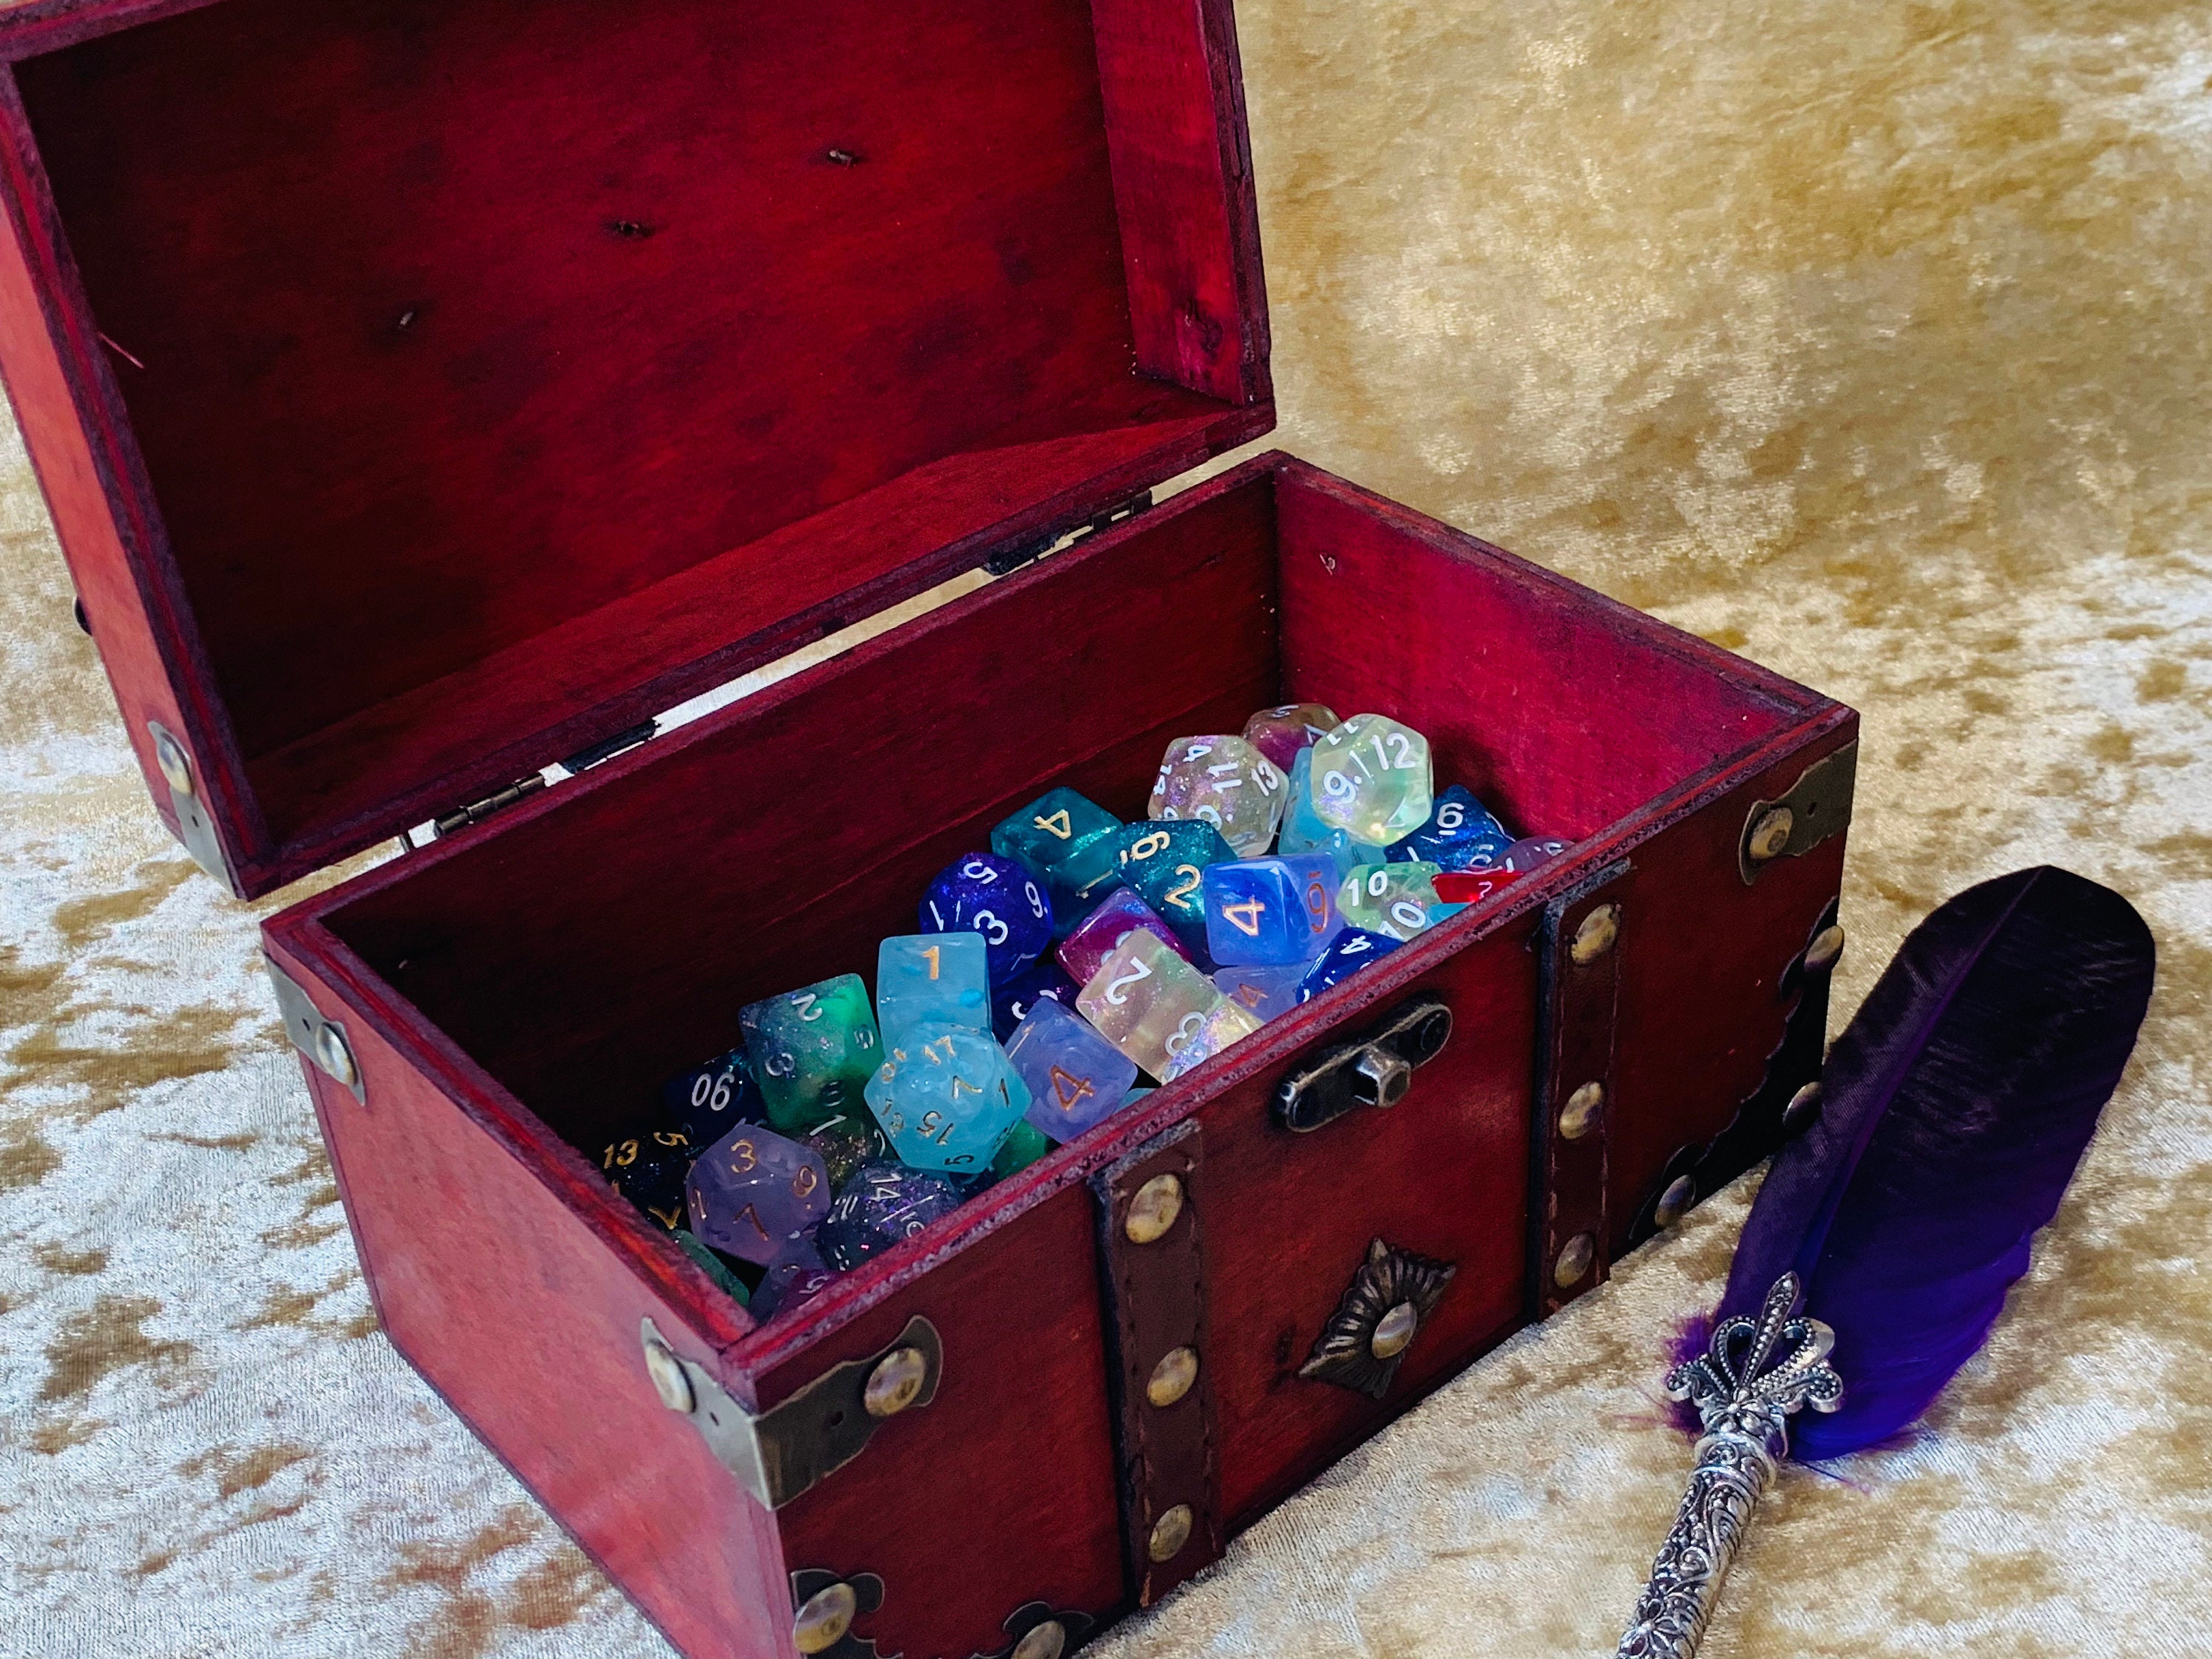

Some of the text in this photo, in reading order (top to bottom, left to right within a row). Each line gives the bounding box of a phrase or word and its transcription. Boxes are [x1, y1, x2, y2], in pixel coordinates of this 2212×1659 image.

[1370, 733, 1416, 771] 12
[1206, 762, 1243, 794] 11
[1251, 759, 1279, 796] 13
[1034, 809, 1072, 840] 4
[1437, 802, 1465, 836] 6
[963, 861, 998, 884] 5
[1164, 863, 1201, 909] 2
[1347, 870, 1388, 907] 10
[973, 908, 1009, 945] 3
[1222, 894, 1265, 936] 4
[921, 945, 940, 980] 1
[1106, 956, 1153, 1006] 2
[791, 992, 824, 1022] 2
[691, 1071, 735, 1112] 06
[952, 1075, 983, 1100] 7
[1049, 1063, 1096, 1112] 4
[917, 1110, 955, 1147] 15
[603, 1138, 639, 1169] 13
[730, 1138, 757, 1174] 3
